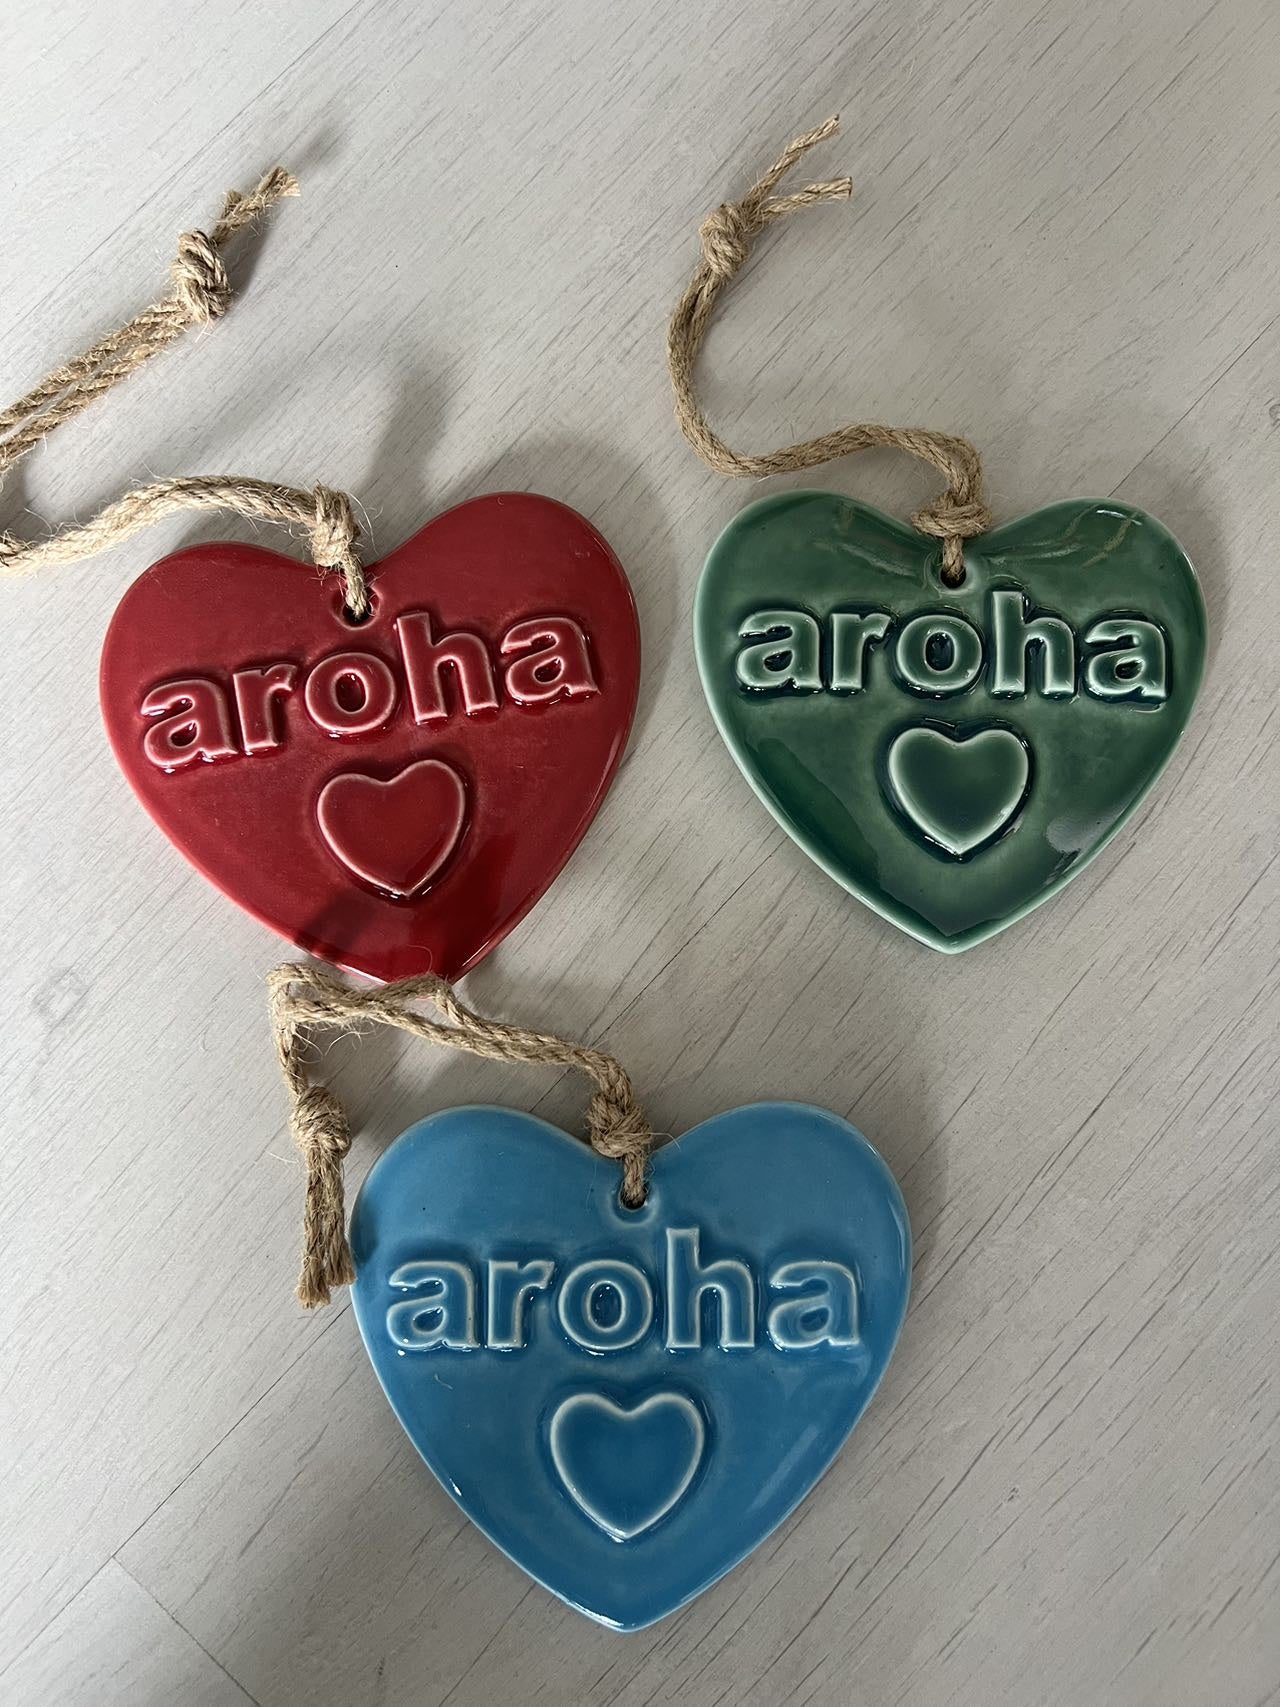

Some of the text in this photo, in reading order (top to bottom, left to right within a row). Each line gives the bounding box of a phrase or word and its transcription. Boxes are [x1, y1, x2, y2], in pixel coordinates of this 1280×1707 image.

[140, 611, 601, 773] aroha
[735, 590, 1169, 699] aroha
[386, 1228, 862, 1354] aroha
